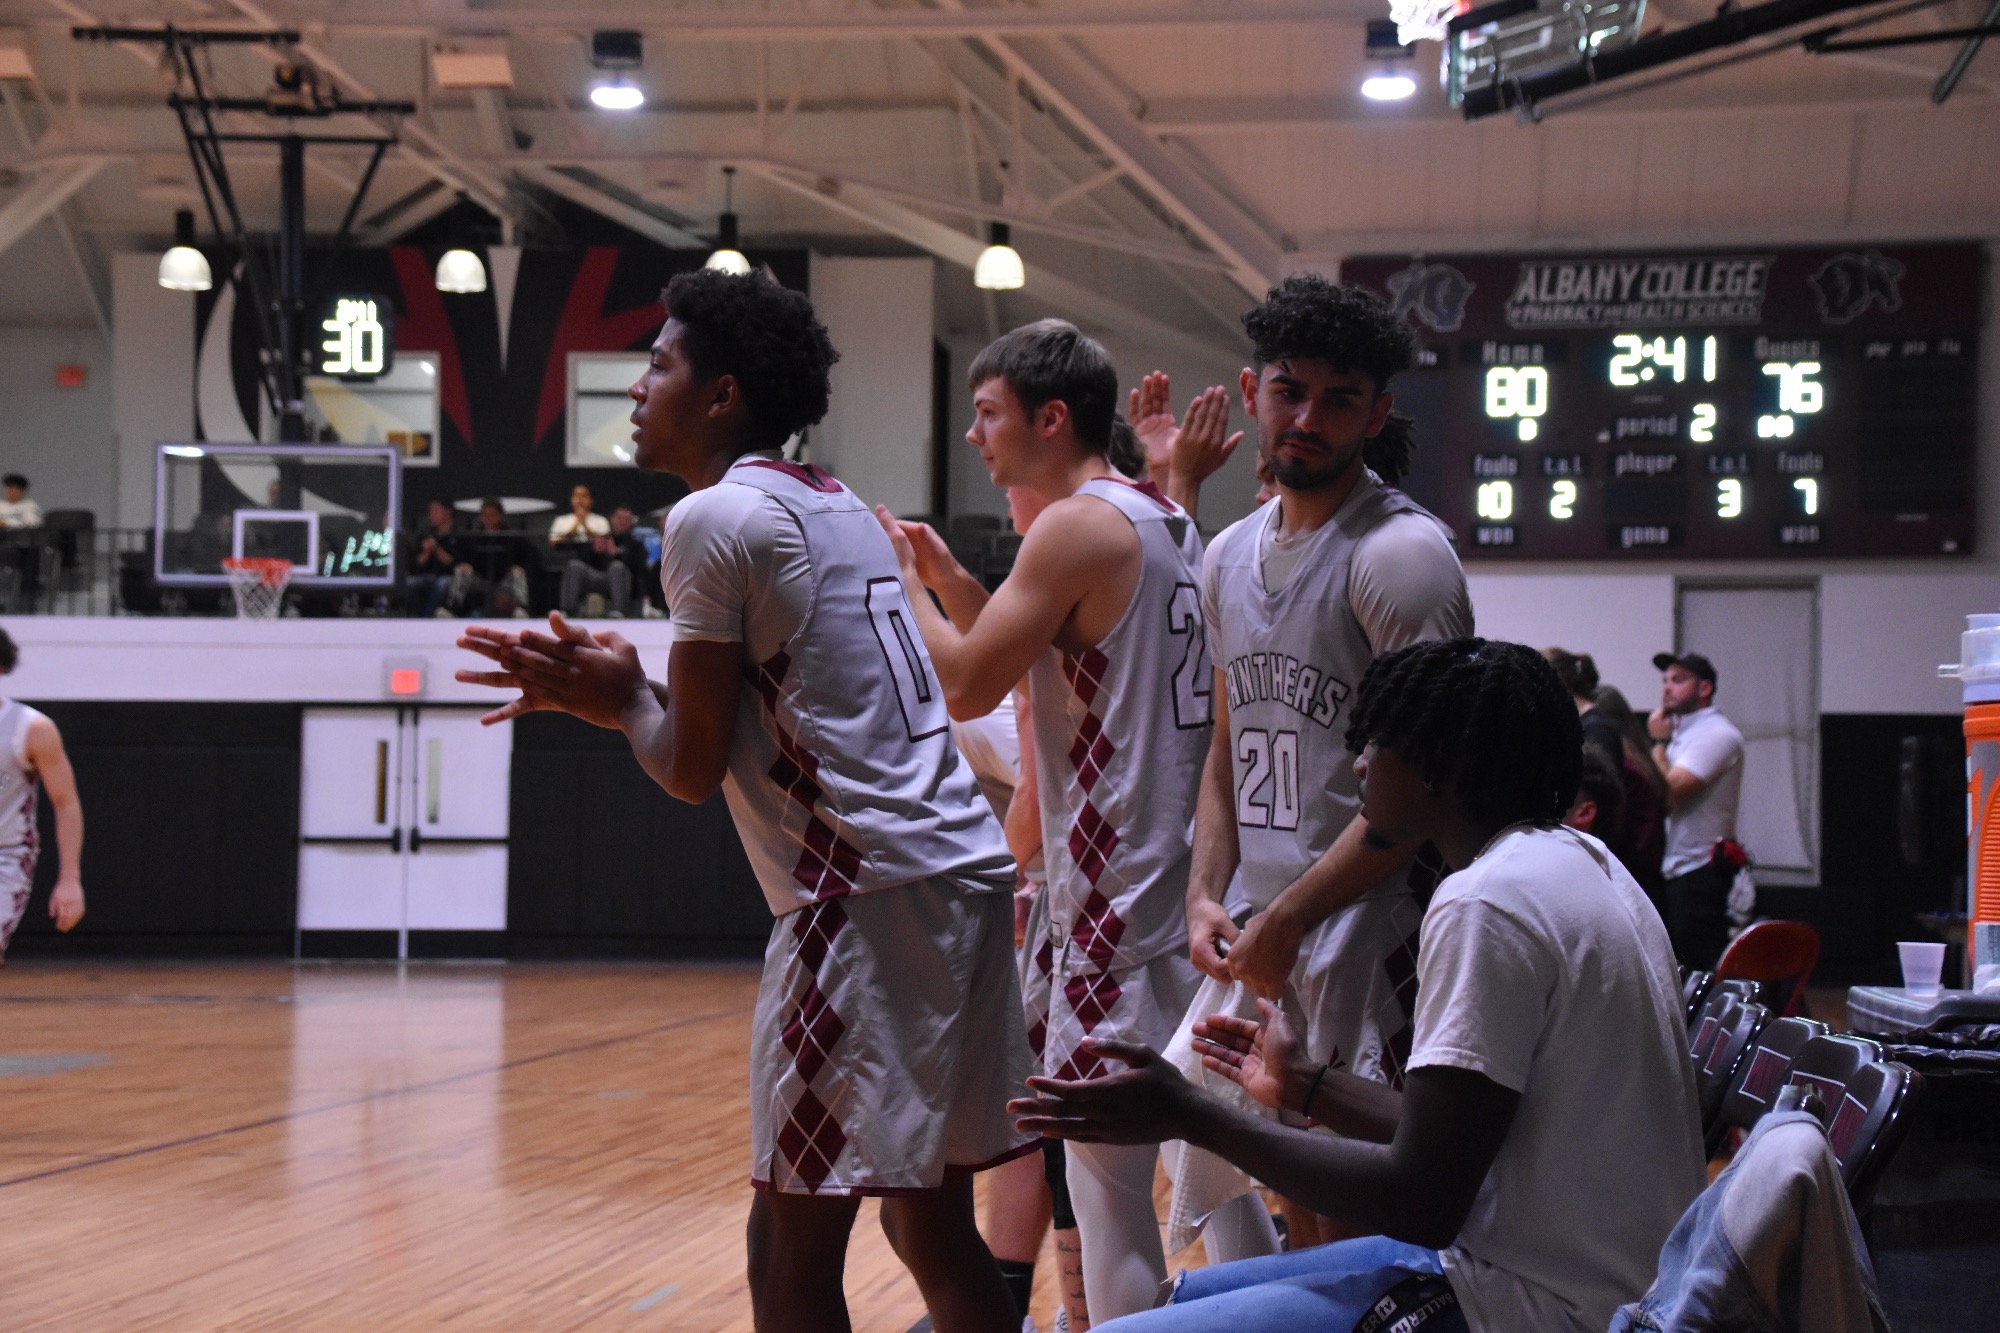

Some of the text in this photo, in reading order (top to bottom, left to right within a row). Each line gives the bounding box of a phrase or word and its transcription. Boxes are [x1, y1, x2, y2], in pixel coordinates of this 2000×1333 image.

[1516, 260, 1767, 302] ALBANY COLLEGE
[322, 319, 384, 373] 30
[1482, 340, 1544, 364] Home
[1609, 334, 1717, 386] 2:41
[1754, 336, 1820, 360] Guests
[1485, 366, 1548, 418] 80
[1761, 361, 1823, 414] 76
[1616, 414, 1678, 439] period
[1690, 403, 1716, 442] 2
[1615, 451, 1677, 478] player
[1477, 480, 1513, 519] 10
[1550, 480, 1577, 519] 2
[1717, 478, 1741, 518] 3
[1793, 478, 1817, 515] 7
[1477, 527, 1514, 545] won
[1621, 526, 1669, 549] game
[1780, 526, 1820, 544] won
[1227, 652, 1350, 729] ANTHERS
[1238, 728, 1300, 831] 20
[1408, 1292, 1455, 1328] BALLER
